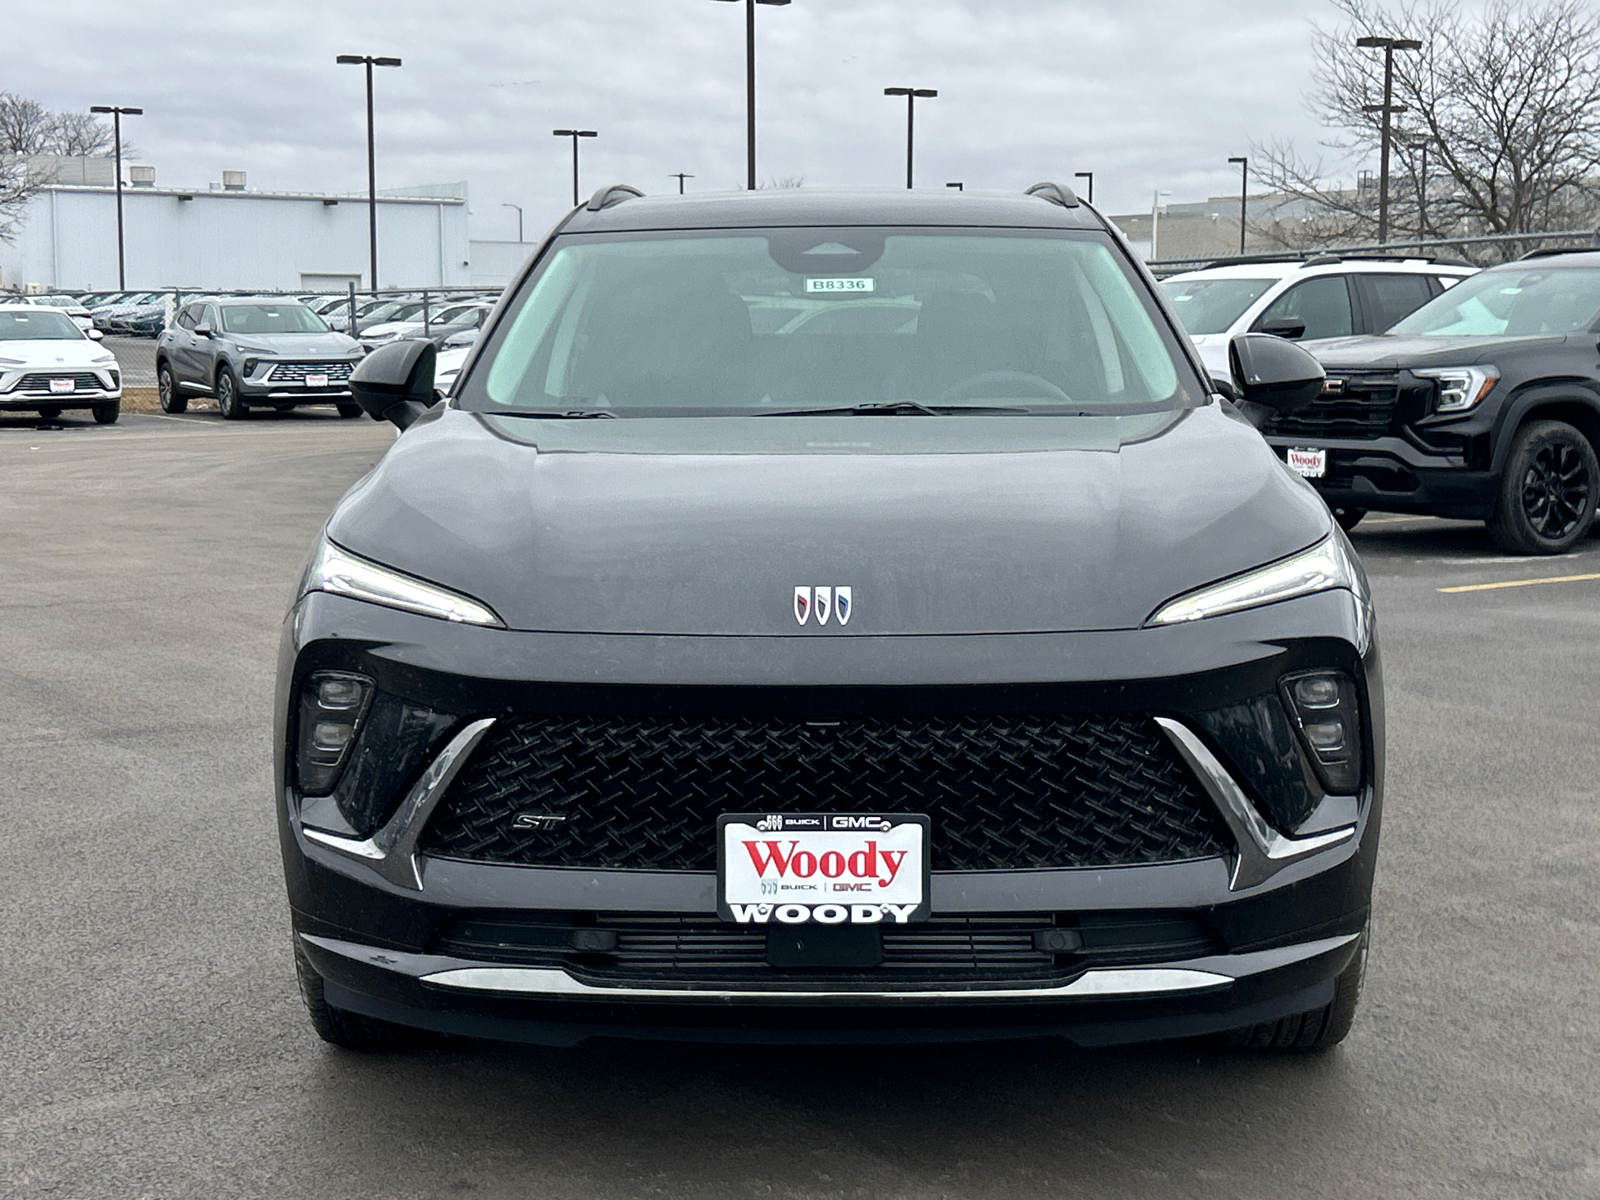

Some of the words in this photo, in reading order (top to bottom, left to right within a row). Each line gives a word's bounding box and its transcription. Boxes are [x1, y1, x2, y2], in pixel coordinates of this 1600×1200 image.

[813, 280, 866, 290] B8336
[1291, 453, 1322, 468] Woody
[512, 814, 566, 830] ST
[832, 816, 882, 828] GMC
[741, 840, 908, 888] Woody
[832, 883, 872, 892] GMC
[729, 904, 919, 924] WOODY
